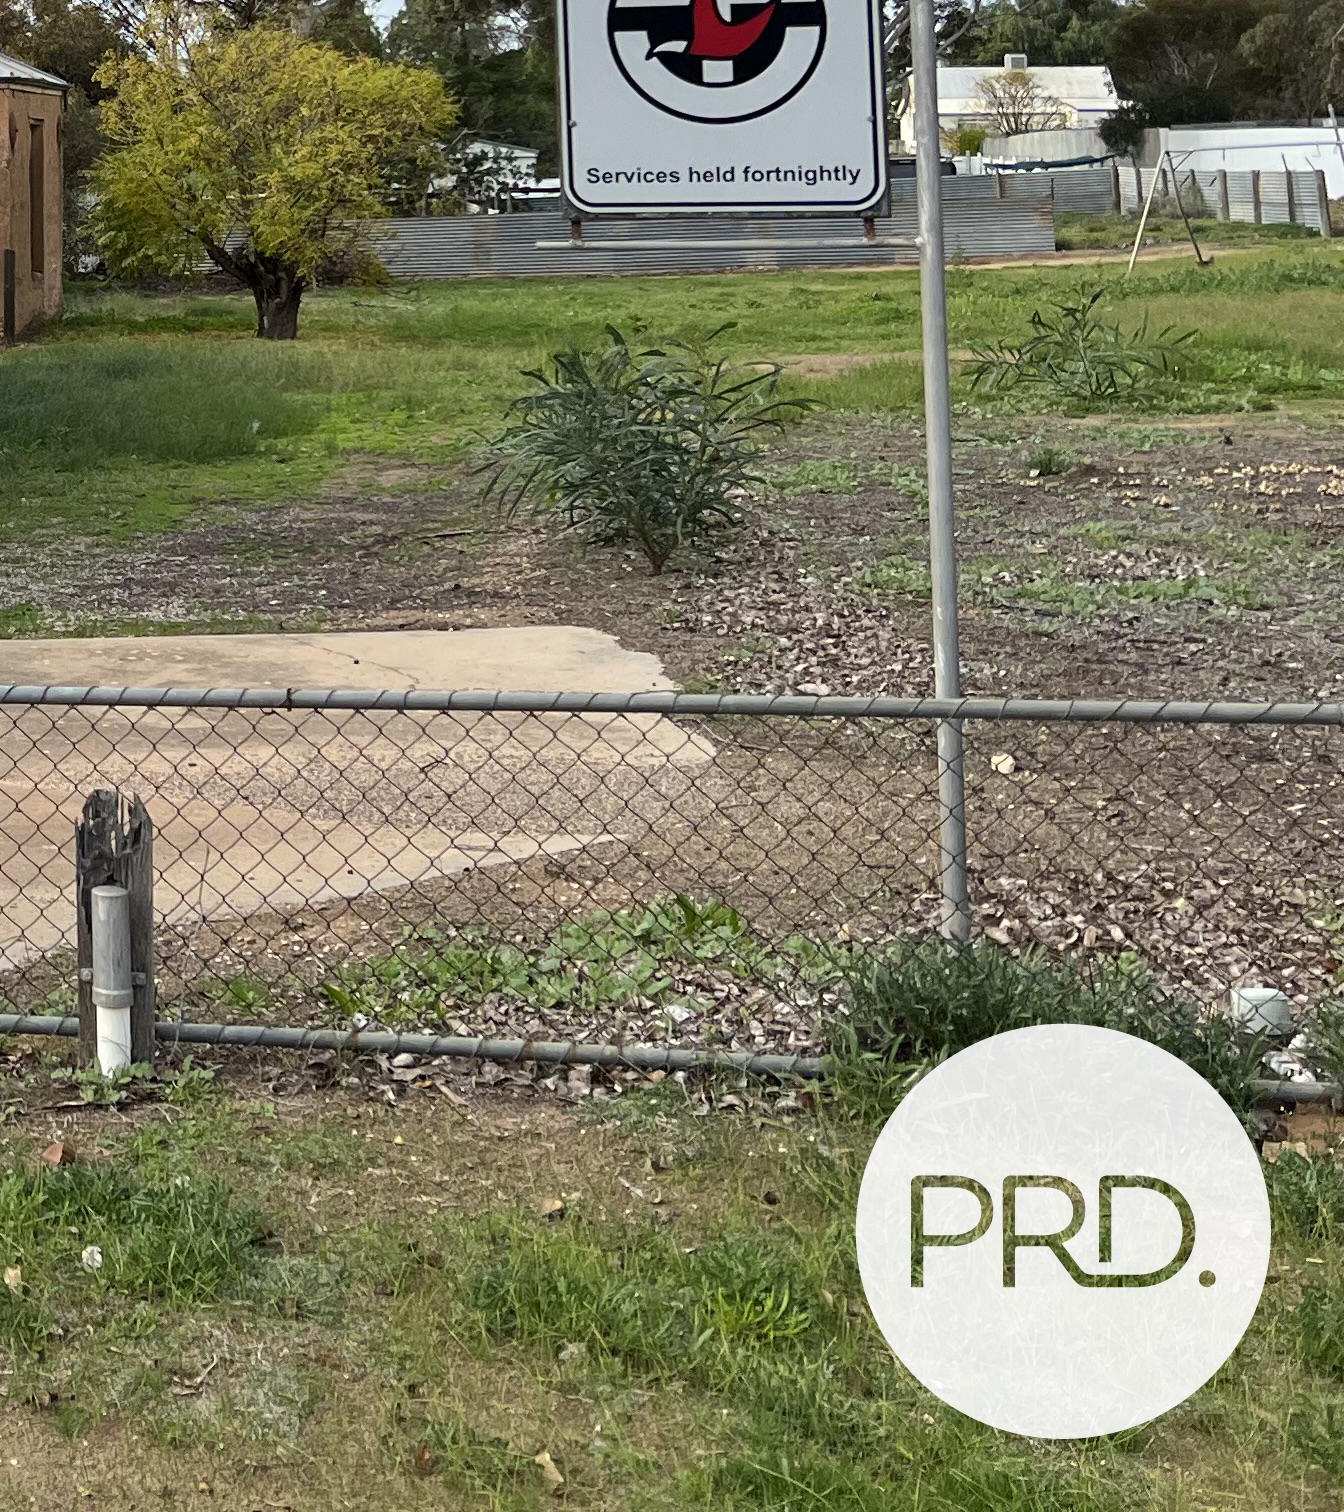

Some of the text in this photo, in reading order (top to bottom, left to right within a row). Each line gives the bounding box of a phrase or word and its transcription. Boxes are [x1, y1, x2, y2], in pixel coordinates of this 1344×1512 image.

[586, 165, 861, 186] Services held fortnightly
